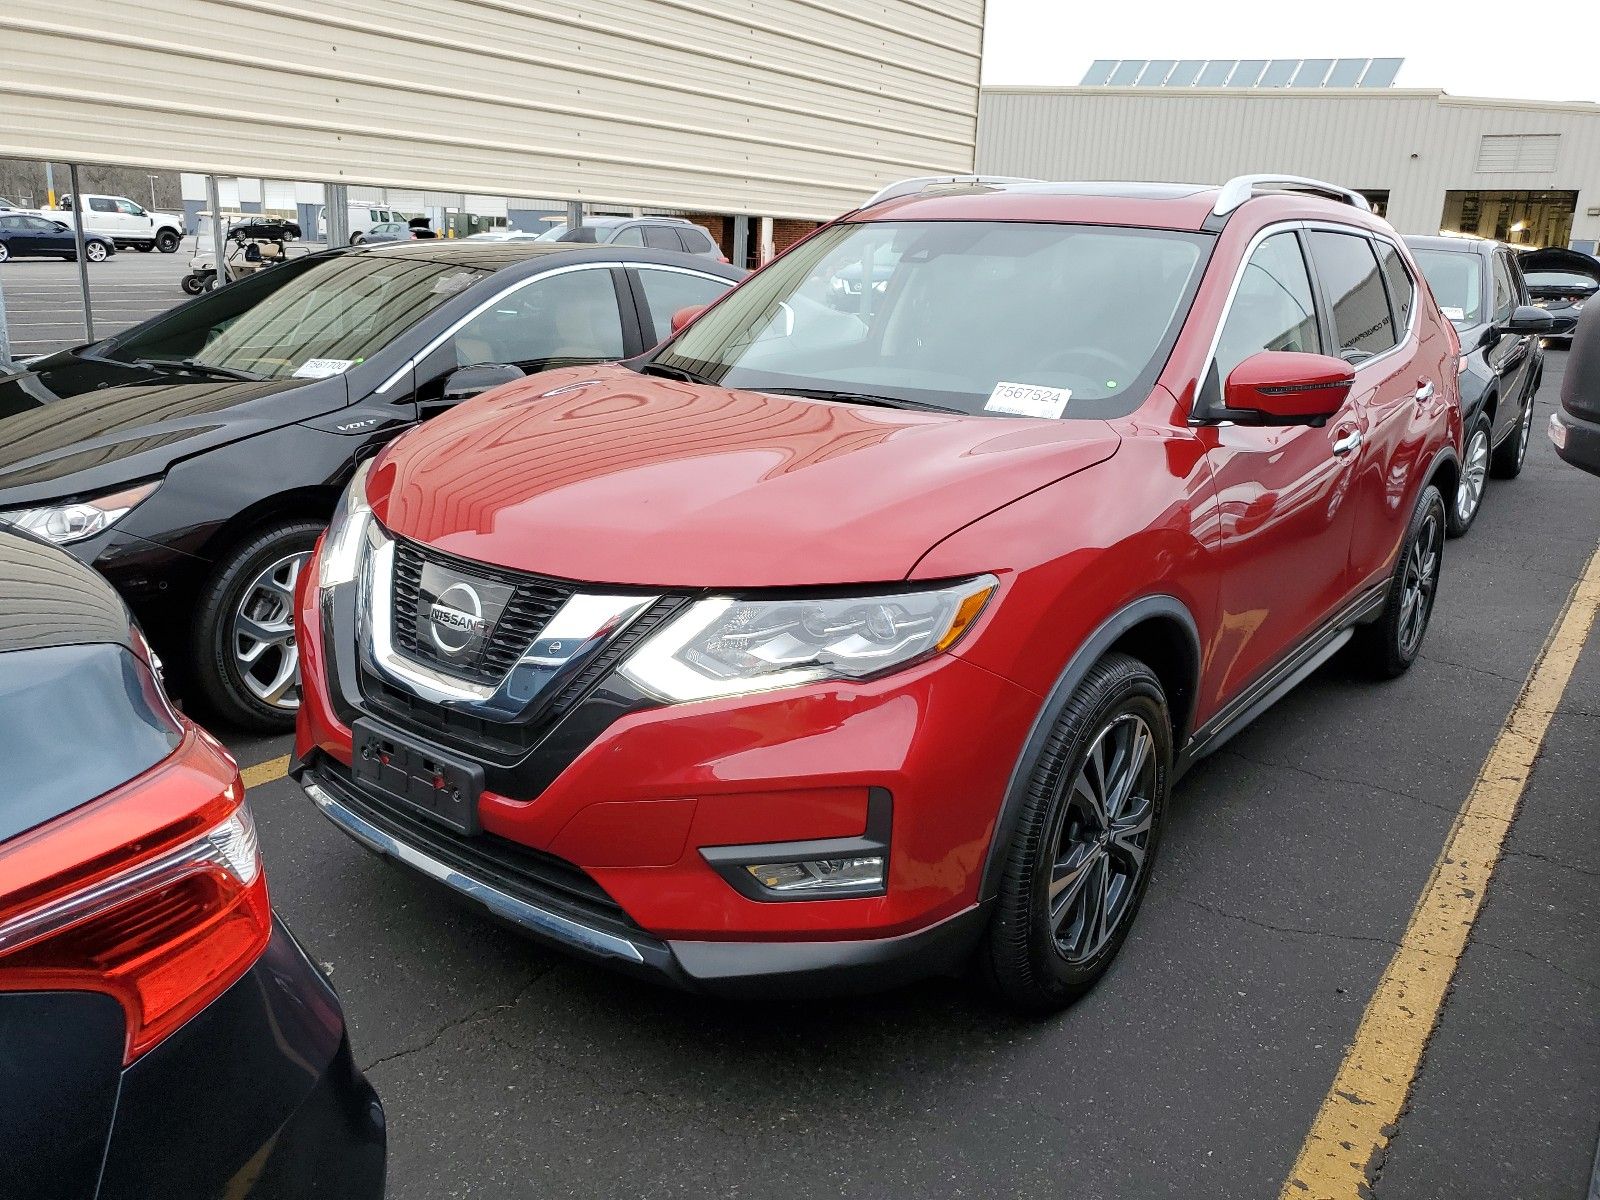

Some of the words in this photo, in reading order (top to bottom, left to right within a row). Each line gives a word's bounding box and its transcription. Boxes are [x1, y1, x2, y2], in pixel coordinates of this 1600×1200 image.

[996, 385, 1061, 404] 7567524
[337, 419, 377, 431] VOLT
[431, 608, 477, 631] NISSAN
